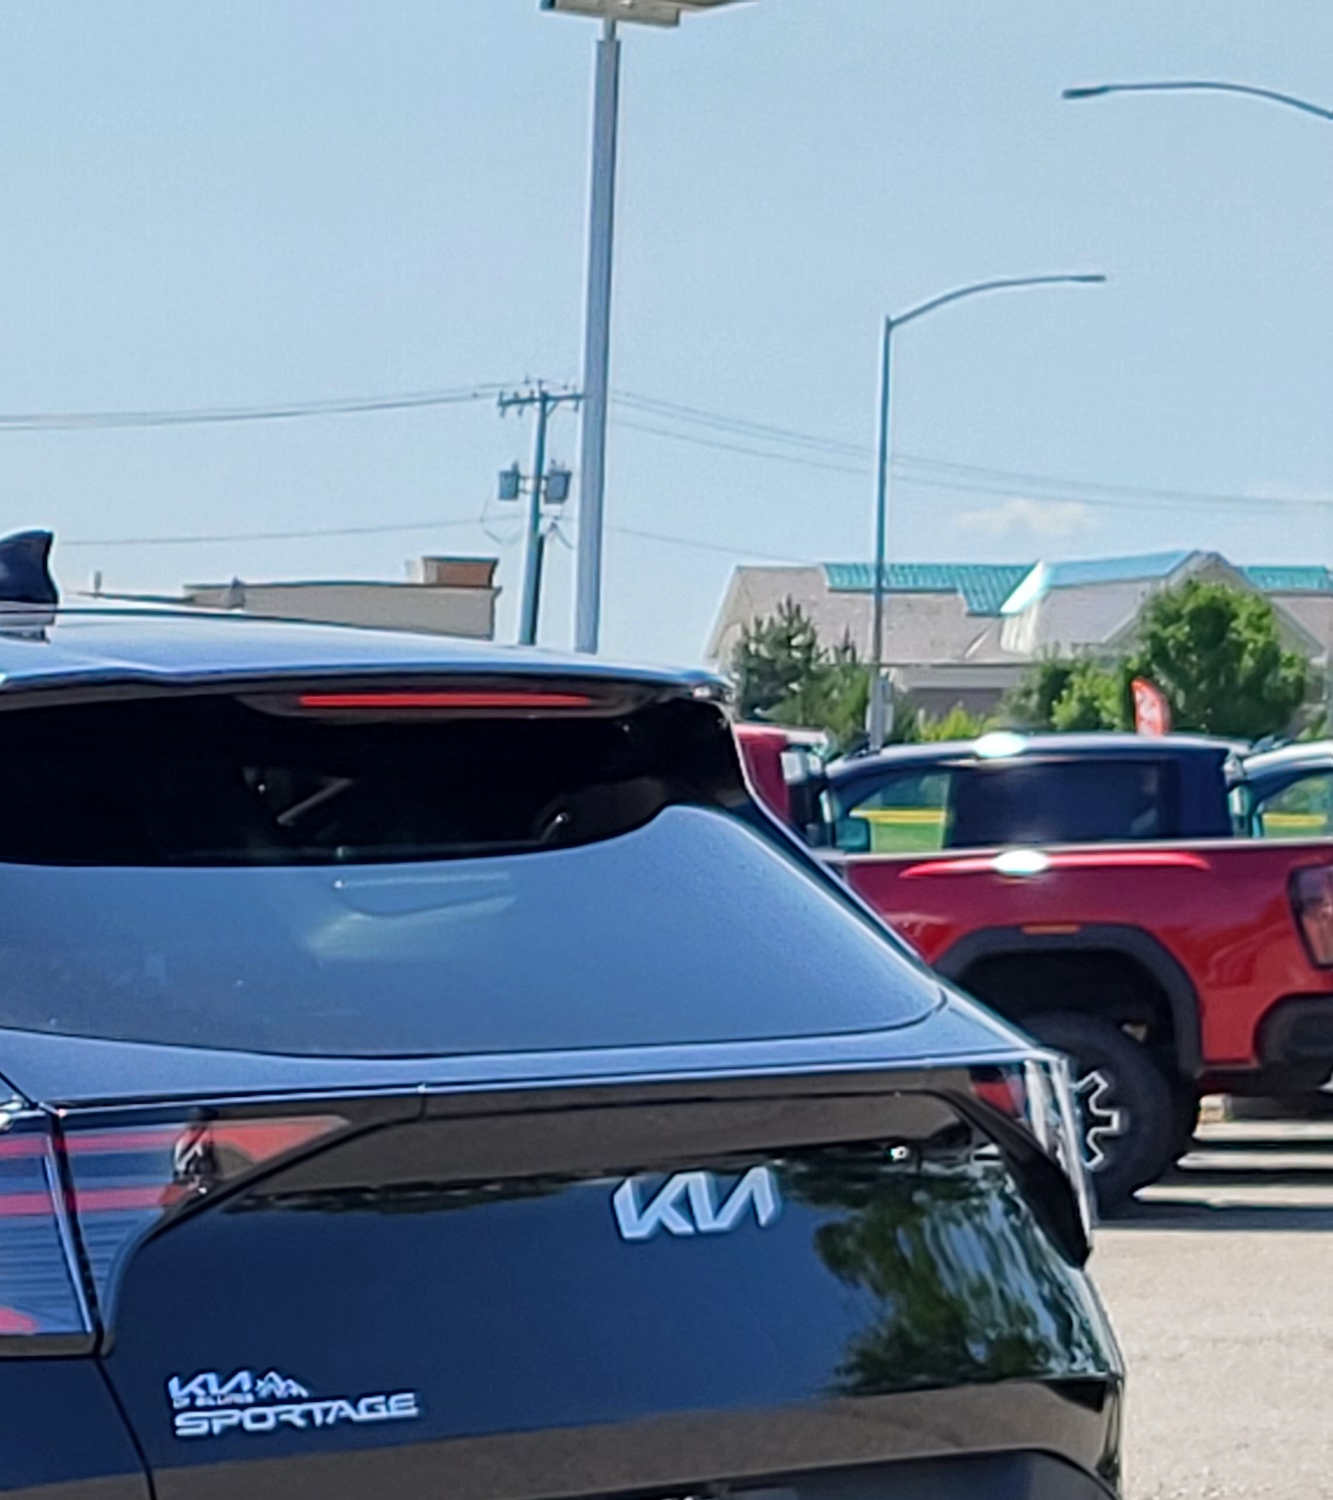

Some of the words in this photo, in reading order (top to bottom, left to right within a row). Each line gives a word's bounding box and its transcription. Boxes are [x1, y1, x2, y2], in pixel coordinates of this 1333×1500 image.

[613, 1166, 775, 1240] KIA
[168, 1370, 251, 1398] KIA
[174, 1393, 420, 1436] SPORTAGE
